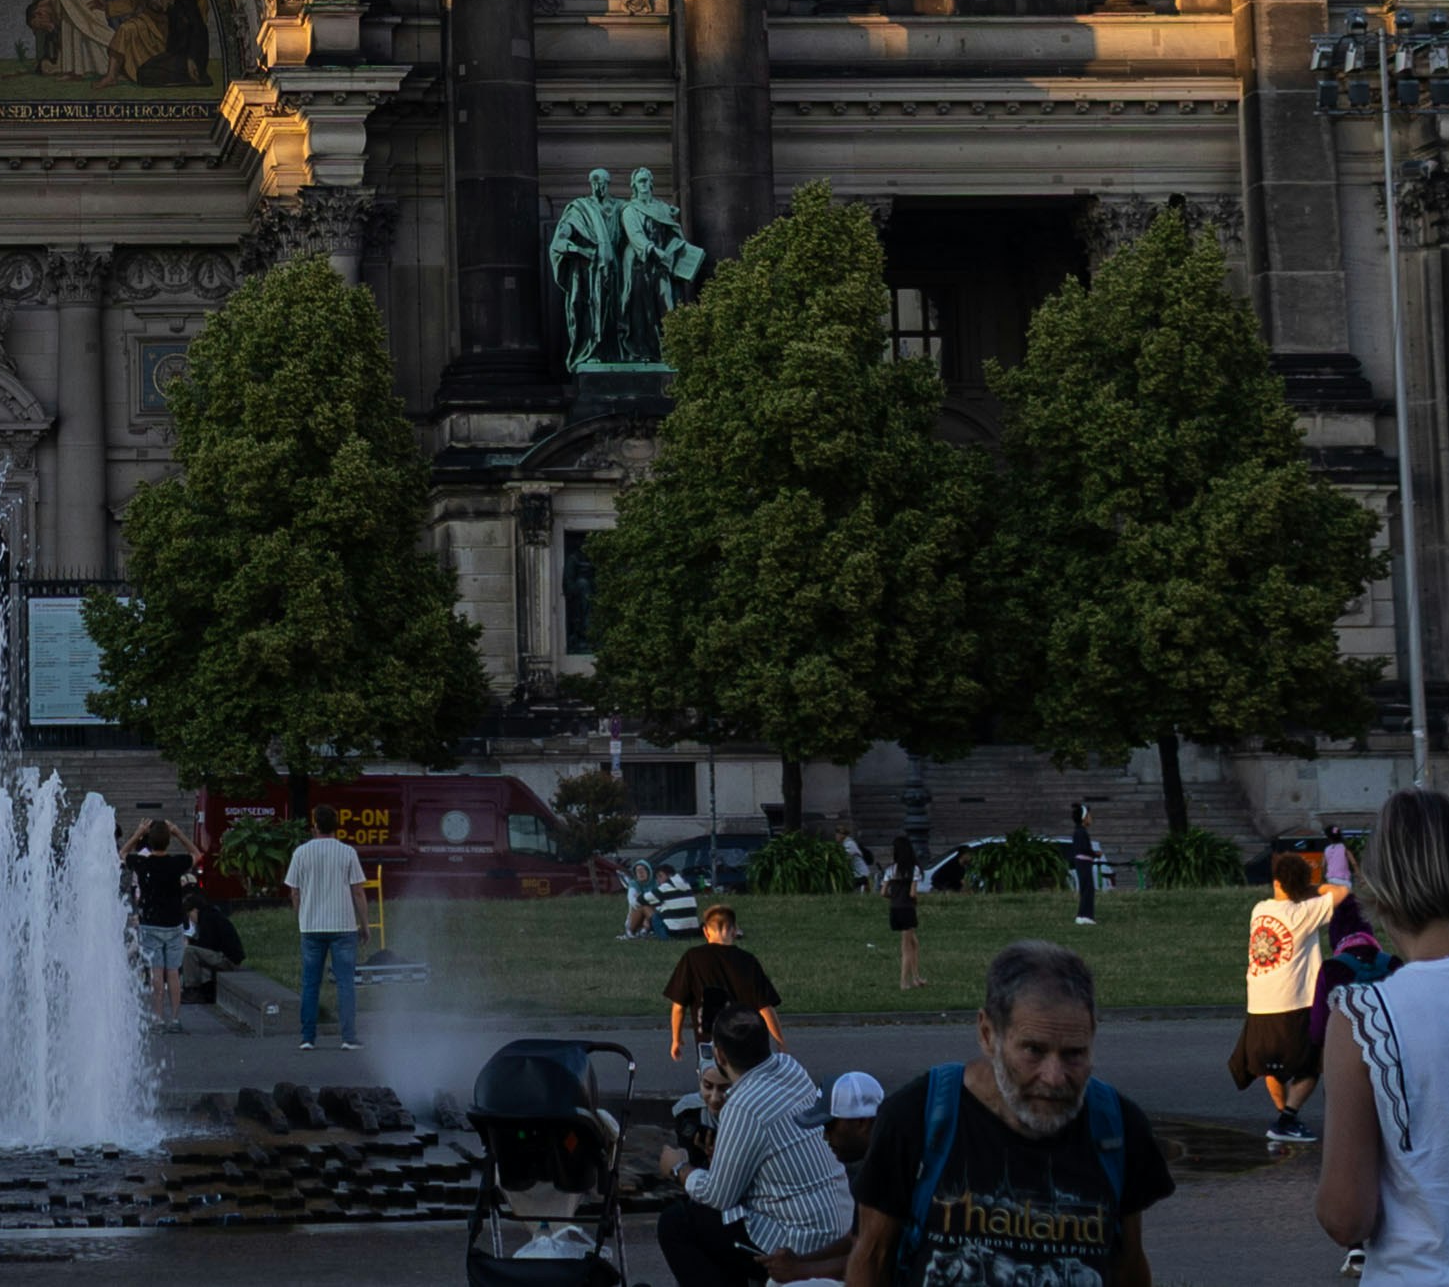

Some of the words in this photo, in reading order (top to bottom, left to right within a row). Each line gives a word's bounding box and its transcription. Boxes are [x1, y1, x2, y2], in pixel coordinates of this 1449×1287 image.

[38, 105, 60, 119] ICH
[62, 105, 92, 119] WILL
[95, 105, 130, 119] EUCH
[134, 105, 209, 119] ERQUICKEN
[932, 1188, 1106, 1245] Thailand
[948, 1234, 1014, 1249] KINGDOM
[1019, 1241, 1035, 1253] OF
